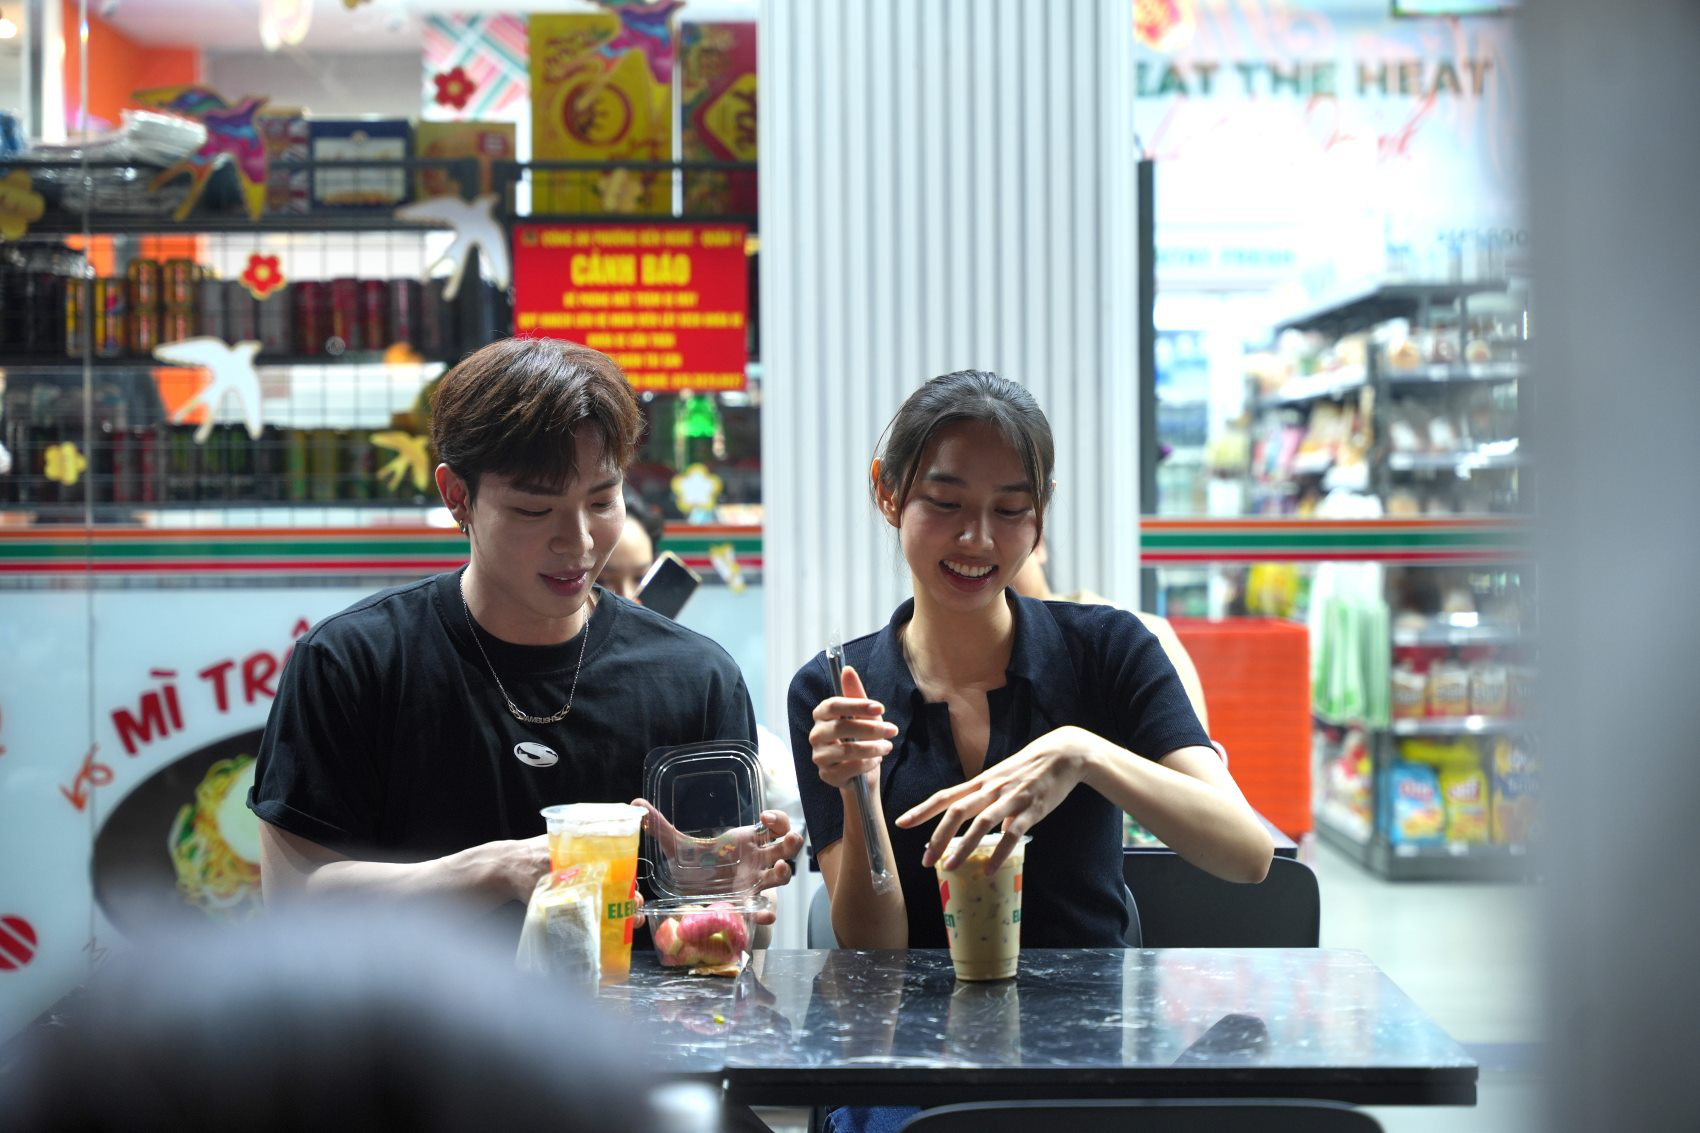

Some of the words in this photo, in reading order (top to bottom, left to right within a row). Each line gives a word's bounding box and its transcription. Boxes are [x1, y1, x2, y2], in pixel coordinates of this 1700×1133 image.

[1234, 60, 1336, 97] THE
[1356, 59, 1493, 97] HEAT
[111, 669, 185, 756] MÌ
[198, 616, 311, 713] TR
